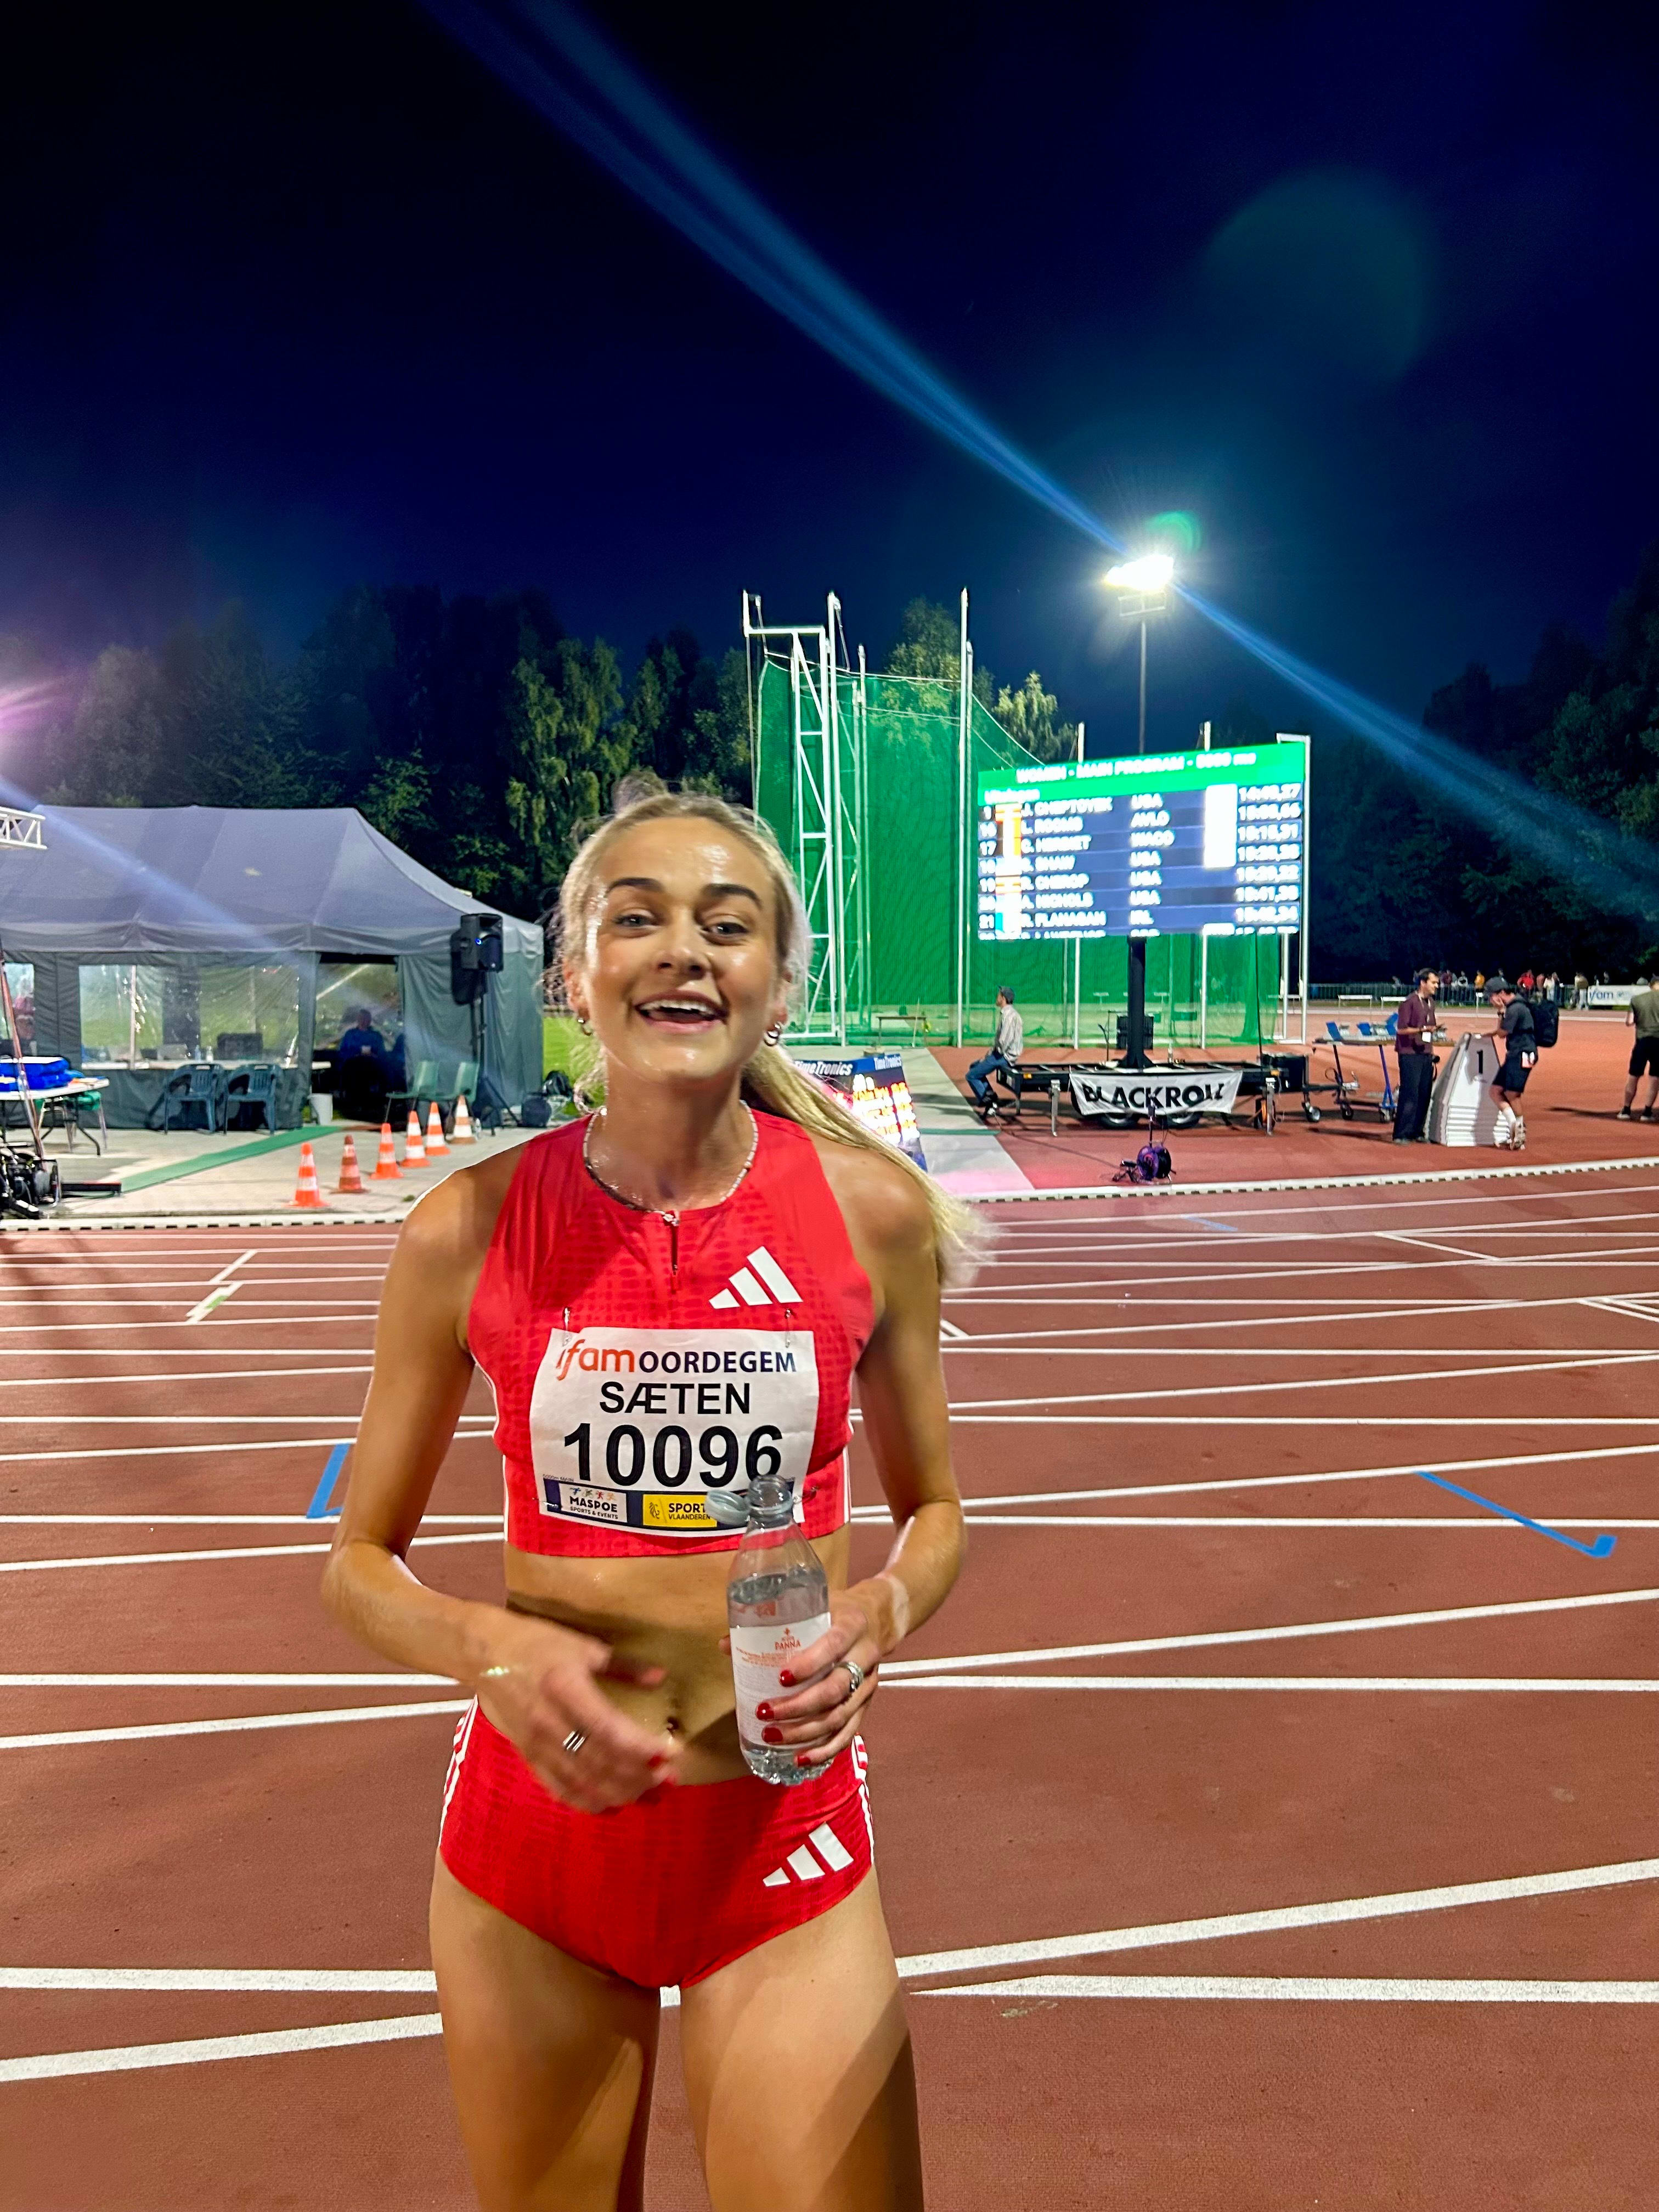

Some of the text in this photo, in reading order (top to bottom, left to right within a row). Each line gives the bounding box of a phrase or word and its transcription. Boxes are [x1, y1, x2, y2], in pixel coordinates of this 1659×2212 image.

[979, 840, 997, 856] 17
[1476, 1049, 1483, 1074] 1
[639, 1351, 797, 1373] OORDEGEM
[600, 1381, 750, 1414] SÆTEN
[564, 1423, 783, 1488] 10096
[569, 1496, 618, 1513] MASPOE
[570, 1506, 591, 1515] SPORTS
[597, 1511, 619, 1520] EVENTS
[775, 1639, 802, 1650] PANNA
